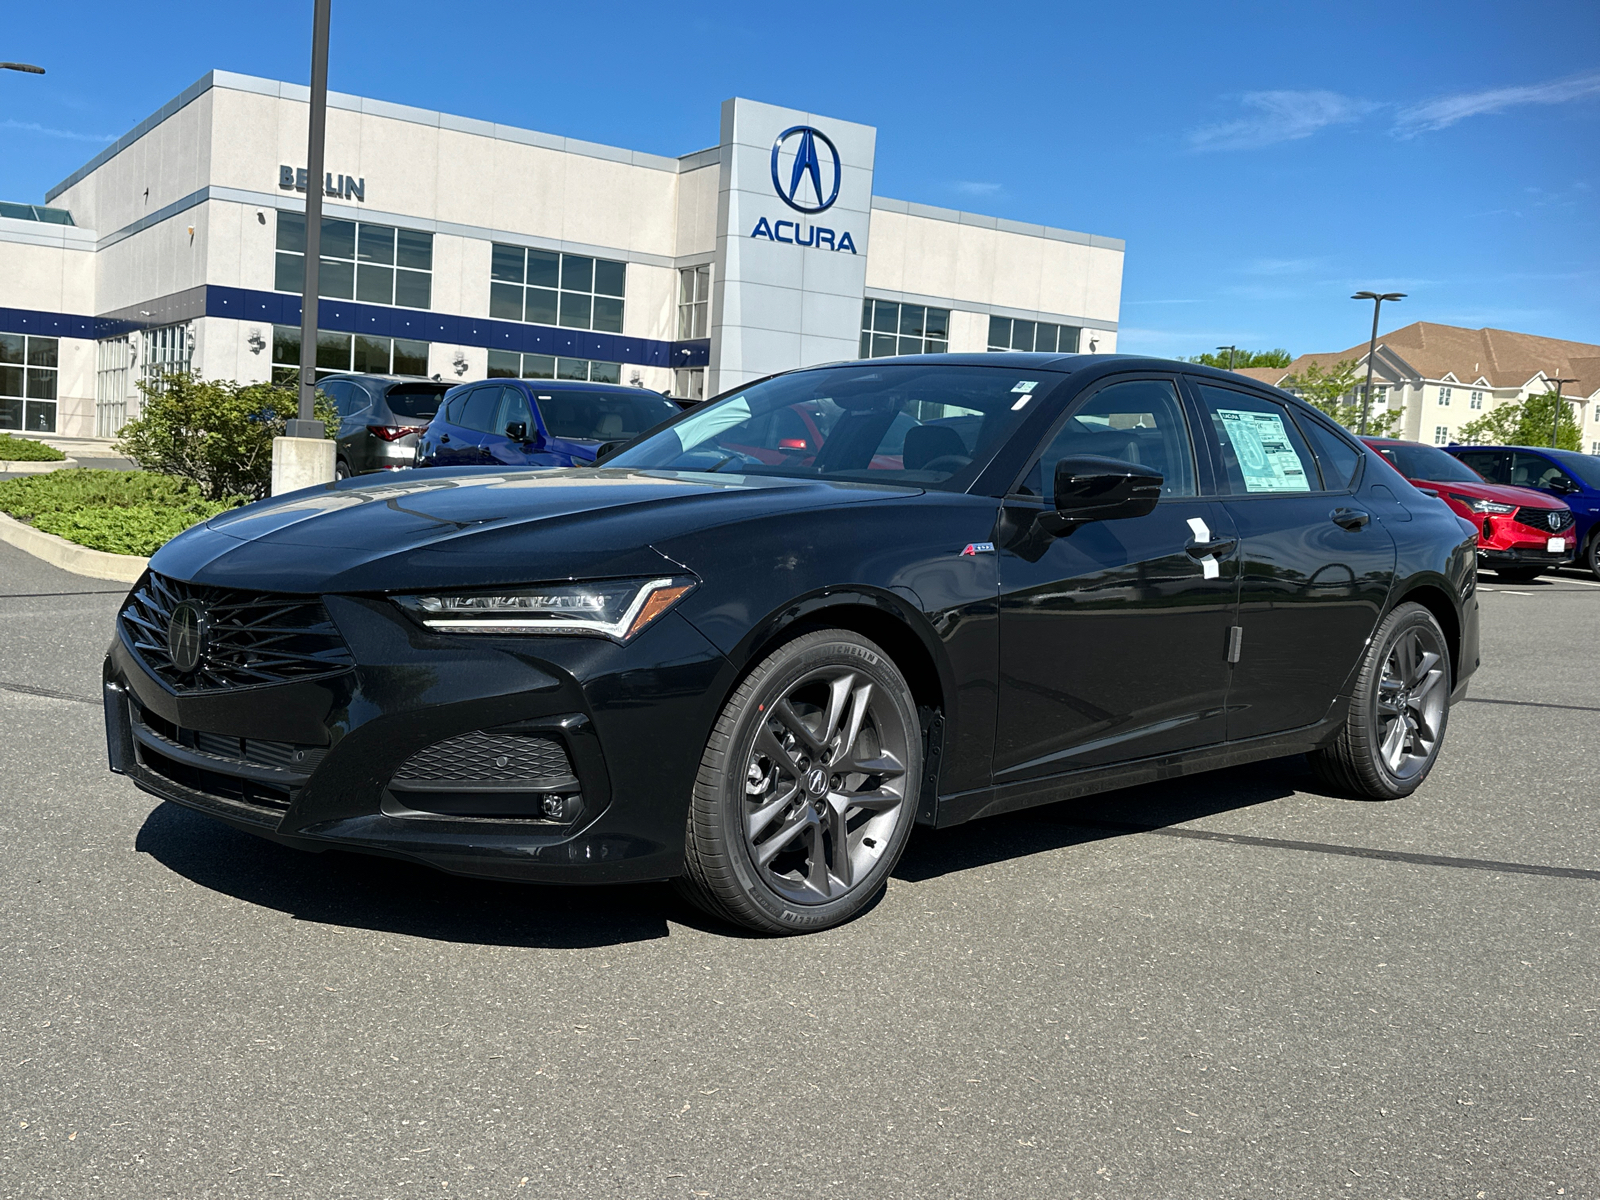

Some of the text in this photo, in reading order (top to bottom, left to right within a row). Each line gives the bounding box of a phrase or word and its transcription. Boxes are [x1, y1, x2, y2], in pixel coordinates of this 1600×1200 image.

[279, 165, 364, 201] BELIN
[750, 216, 857, 254] ACURA
[821, 645, 875, 662] MICHELIN
